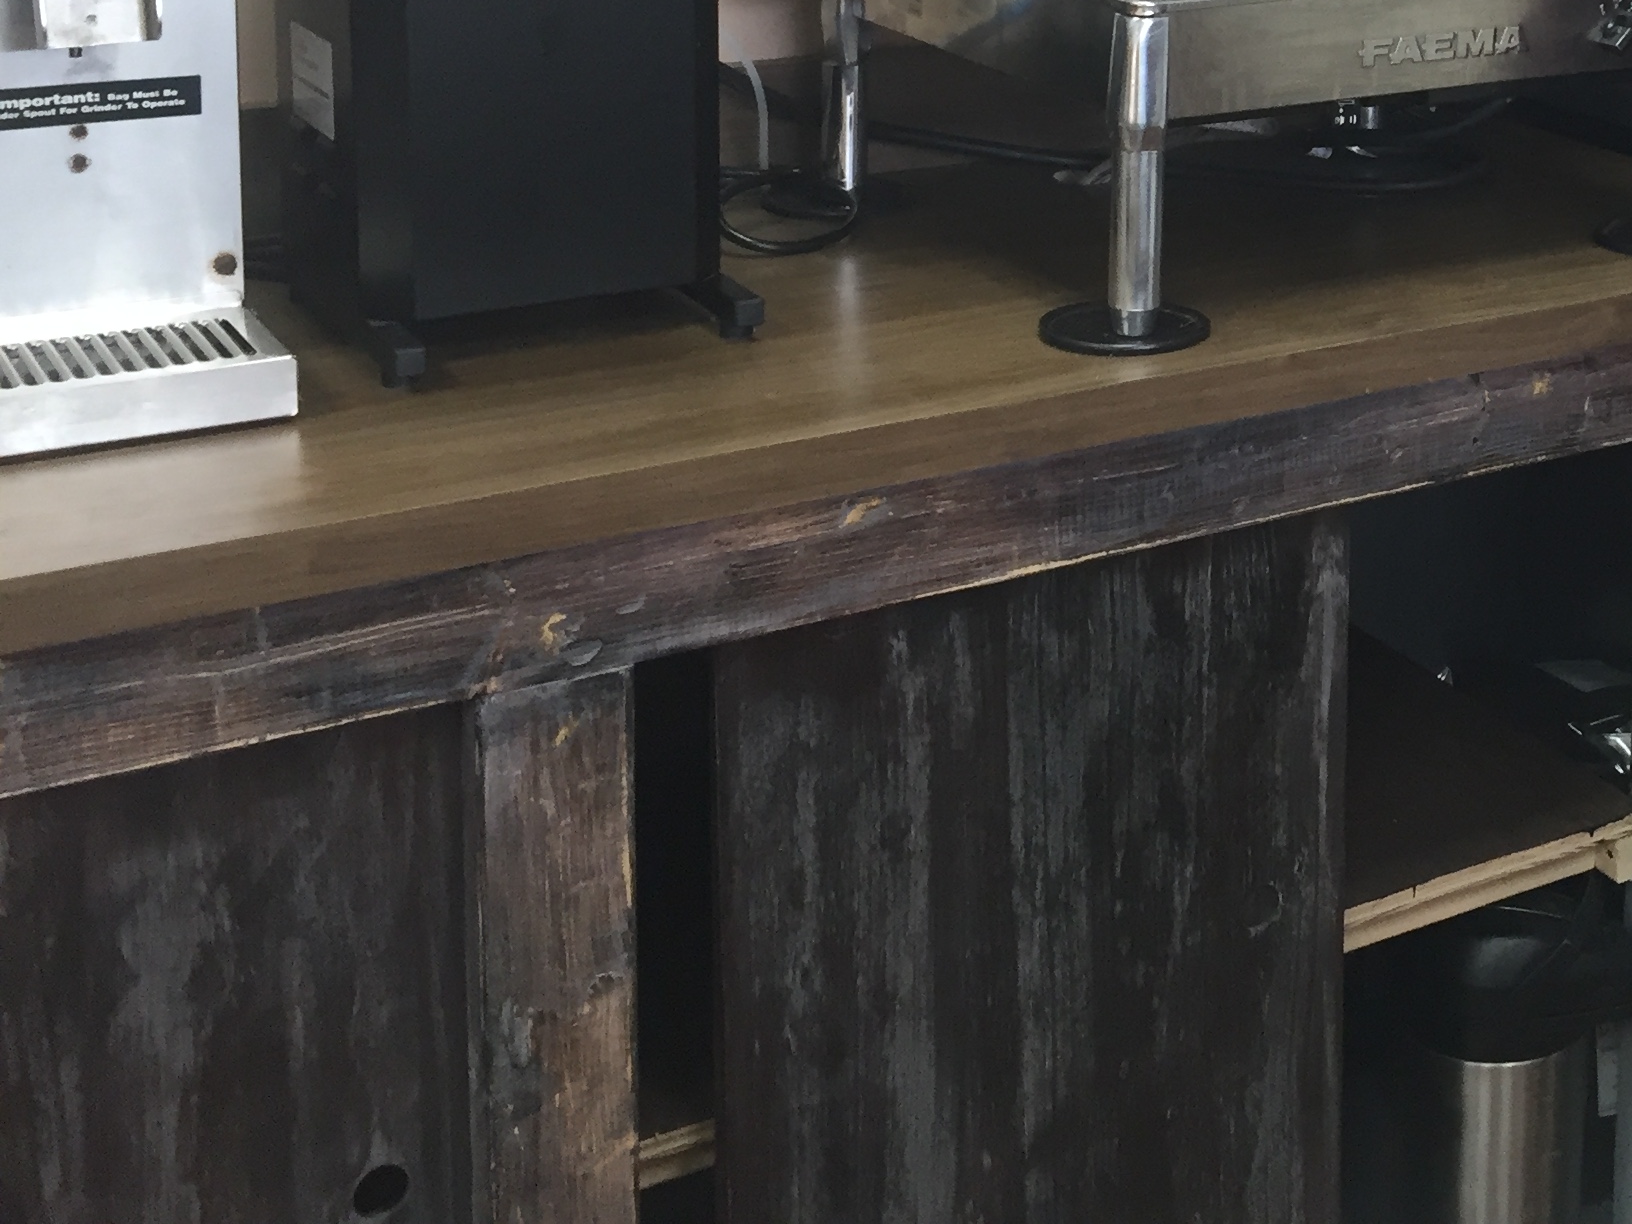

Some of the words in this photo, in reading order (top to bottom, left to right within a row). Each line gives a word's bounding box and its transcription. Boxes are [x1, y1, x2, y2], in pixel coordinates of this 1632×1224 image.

[1359, 25, 1523, 67] FAEMA
[107, 93, 130, 102] Bag
[132, 90, 160, 99] Must
[163, 88, 179, 97] Be
[0, 111, 20, 120] der
[23, 108, 56, 119] Spout
[59, 106, 79, 115] For
[81, 103, 123, 114] Grinder
[126, 101, 139, 109] To
[141, 98, 186, 109] Operate
